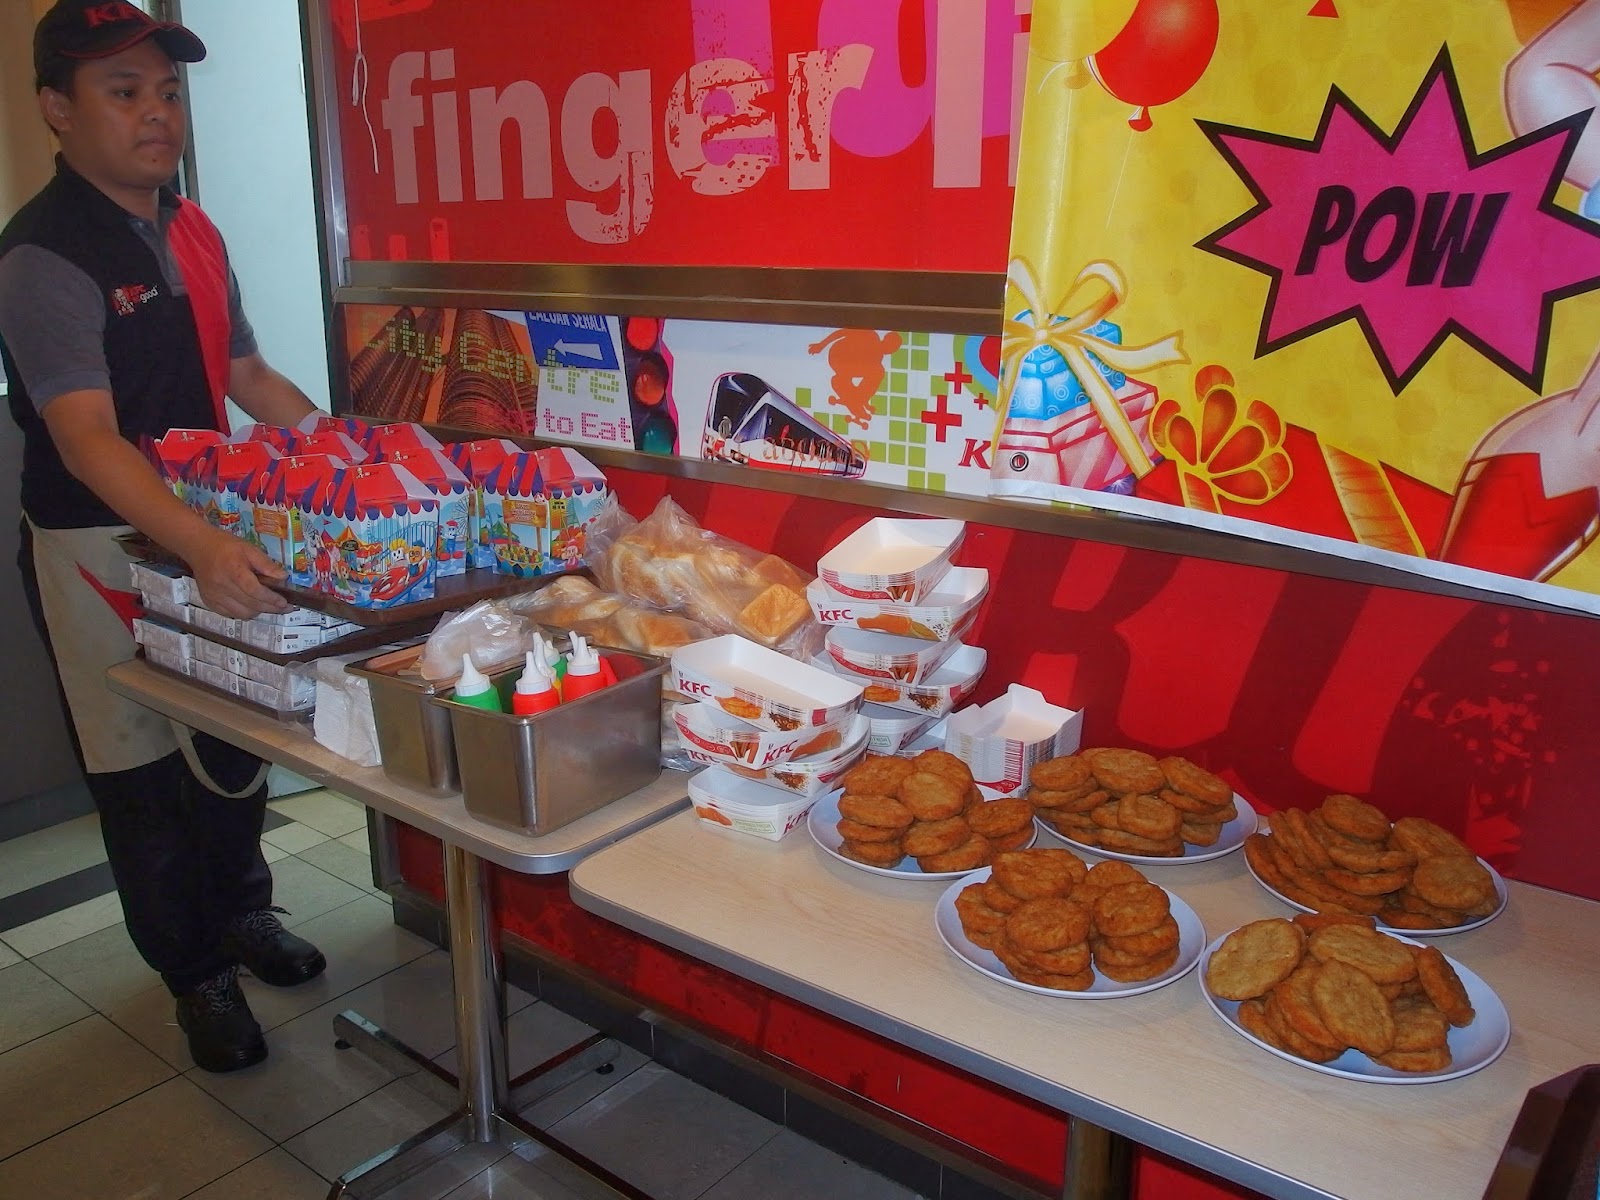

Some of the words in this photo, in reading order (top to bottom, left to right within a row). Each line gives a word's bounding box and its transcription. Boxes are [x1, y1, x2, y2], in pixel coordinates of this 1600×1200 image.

[381, 43, 874, 245] finger
[1294, 184, 1510, 288] POW
[543, 408, 574, 435] to
[581, 412, 632, 443] Eat
[818, 609, 854, 622] KFC
[679, 679, 712, 697] KFC
[762, 740, 799, 765] KFC
